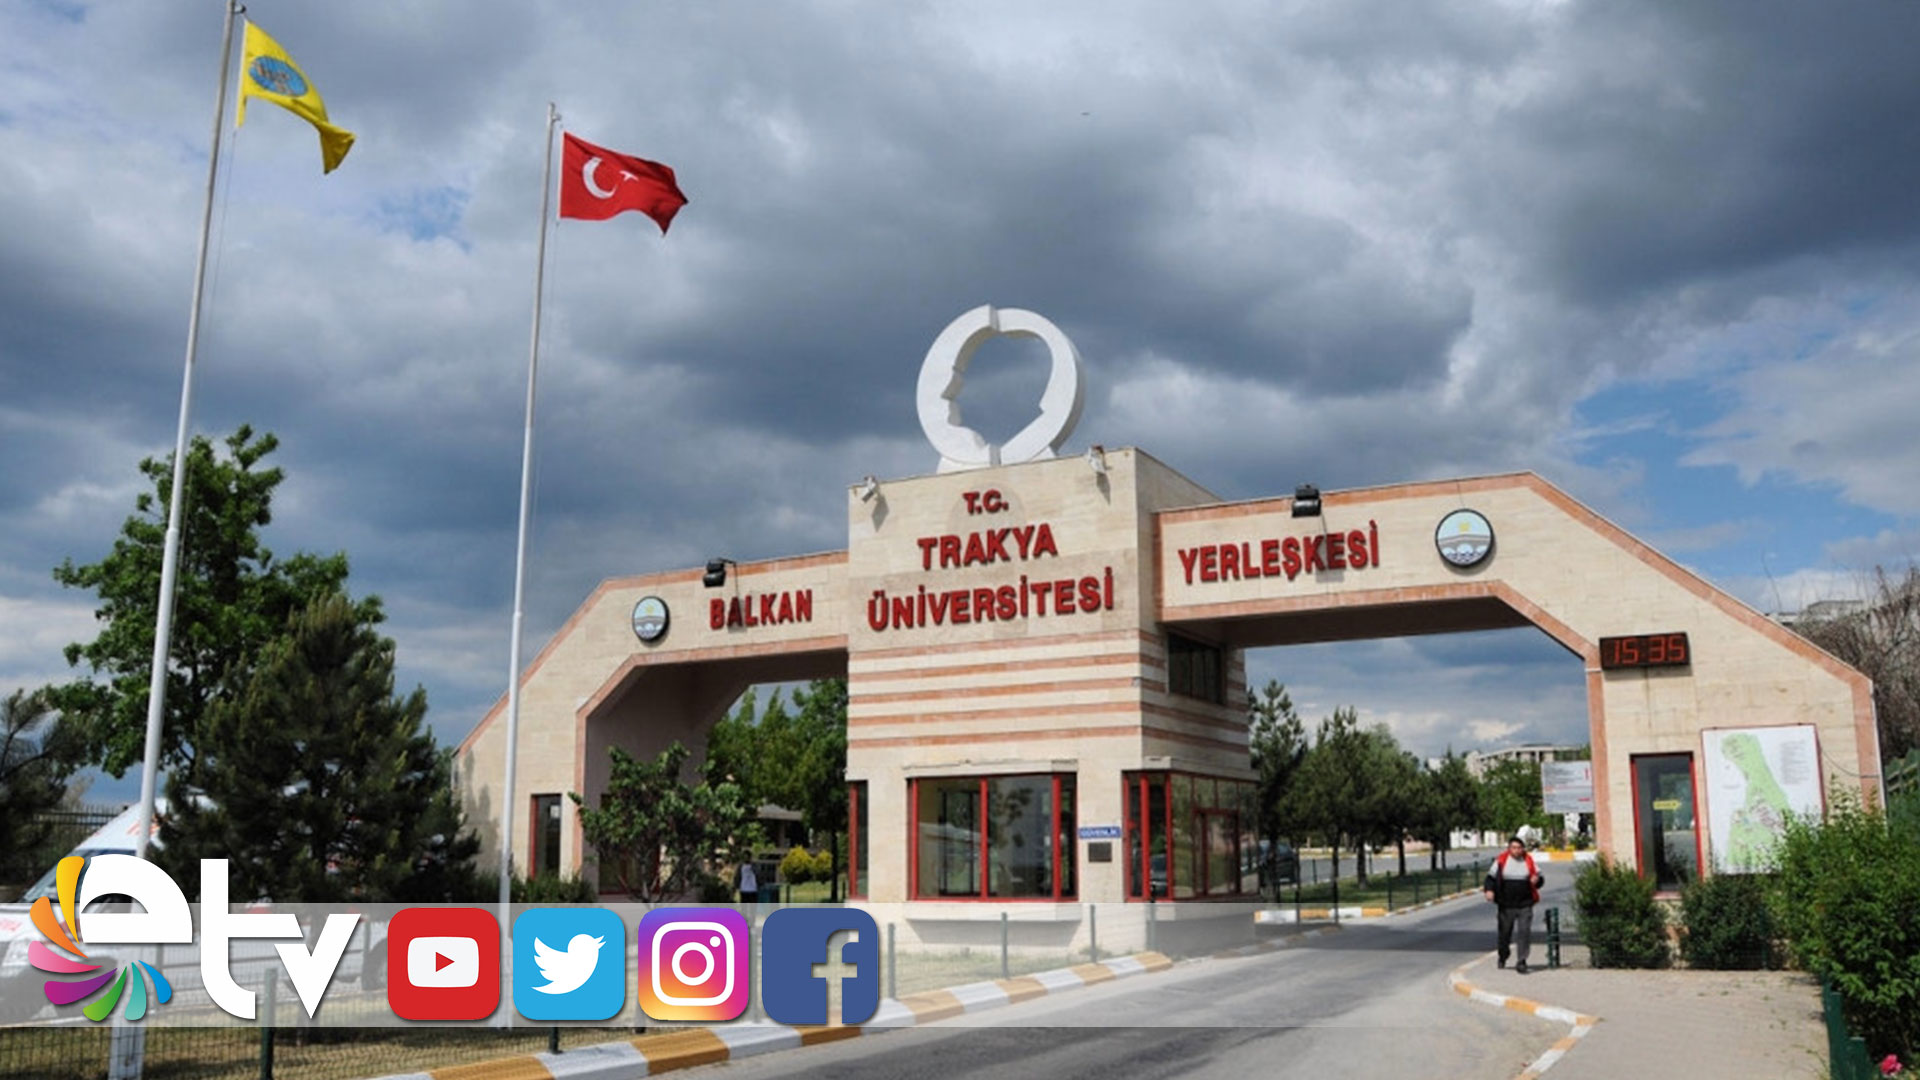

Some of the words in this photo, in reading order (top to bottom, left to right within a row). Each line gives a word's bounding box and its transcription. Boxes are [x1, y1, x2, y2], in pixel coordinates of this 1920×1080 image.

[963, 489, 1009, 514] T.C.
[917, 523, 1058, 571] TRAKYA
[1178, 519, 1380, 584] YERLEŞKESİ
[709, 589, 812, 630] BALKAN
[867, 566, 1114, 632] ÜNİVERSİTESİ
